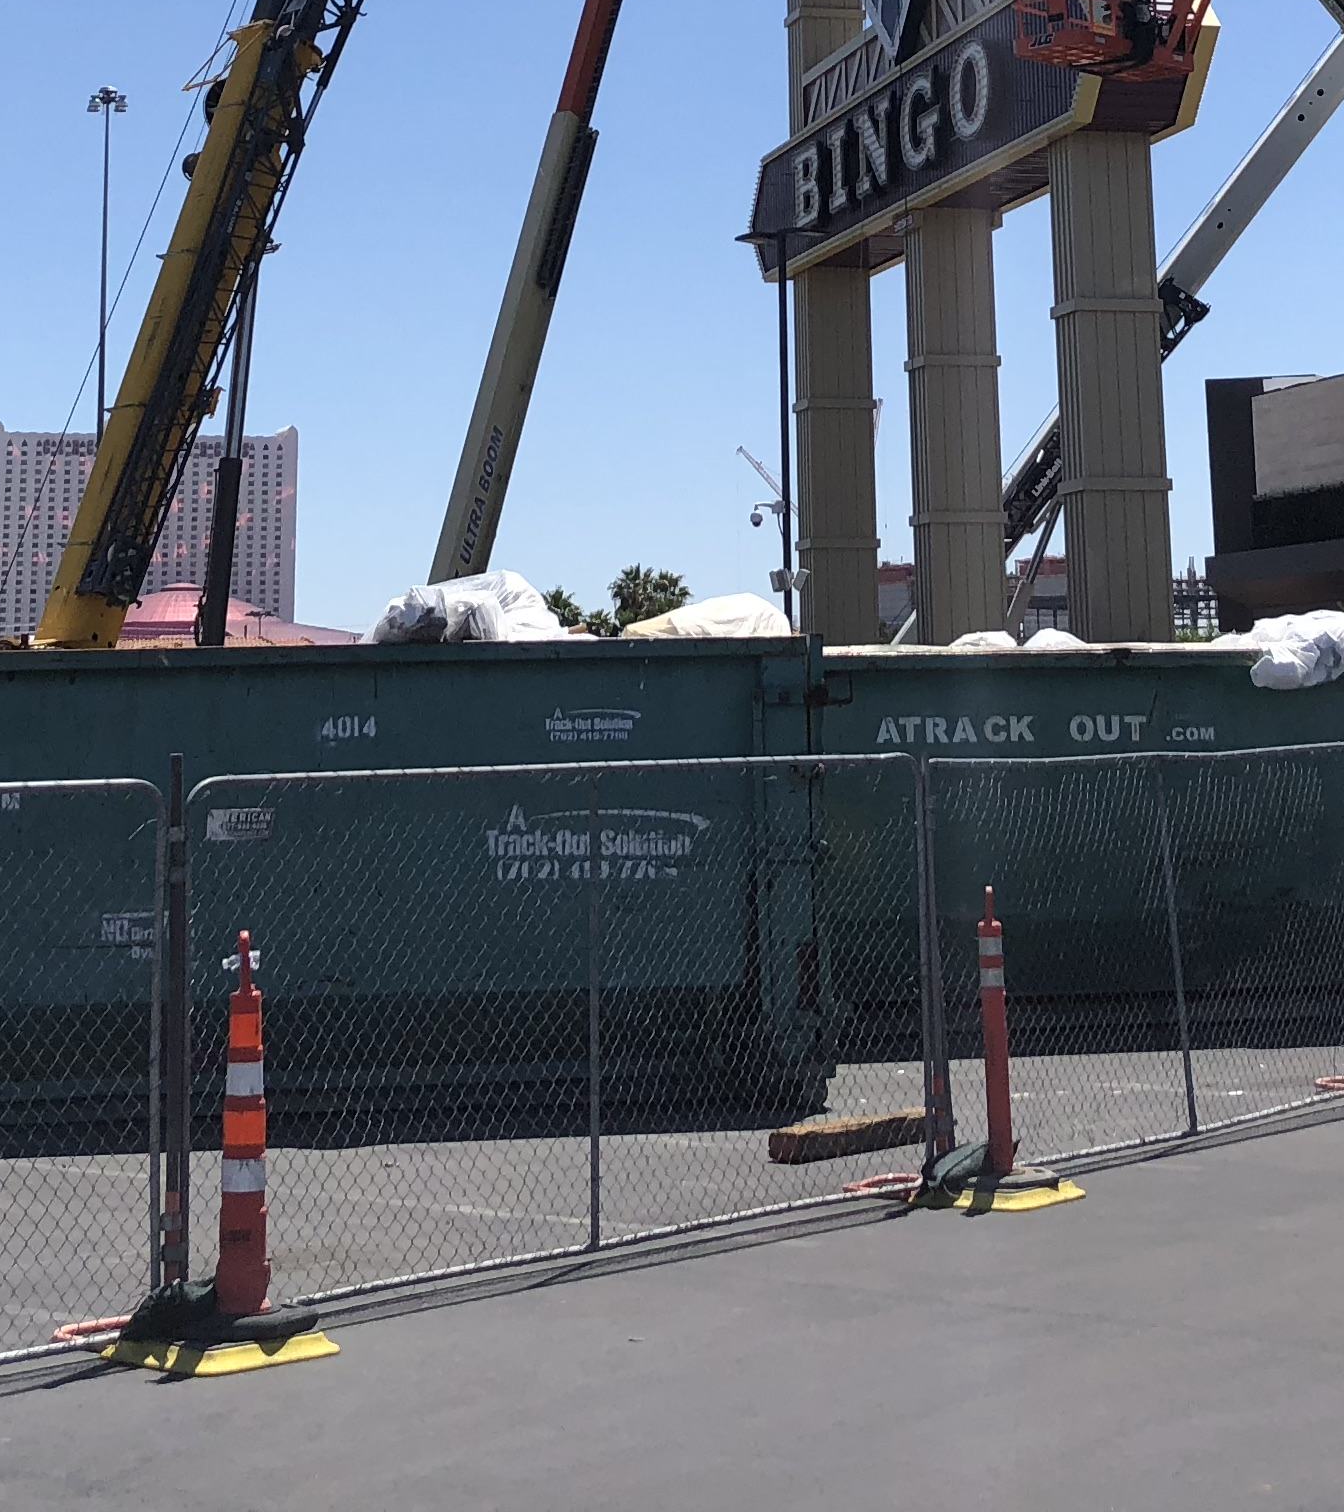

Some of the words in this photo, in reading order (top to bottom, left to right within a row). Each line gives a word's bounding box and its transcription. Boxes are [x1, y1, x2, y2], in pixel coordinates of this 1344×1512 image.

[1029, 33, 1053, 48] JLG
[793, 39, 990, 229] BINGO
[460, 496, 486, 565] ULTRA
[478, 425, 504, 494] BOOM
[321, 715, 377, 738] 4014
[553, 706, 563, 720] A
[876, 716, 1035, 744] ATRACK
[1069, 714, 1147, 742] OUT
[507, 803, 527, 831] A
[486, 829, 591, 856] Track-Out
[600, 829, 692, 856] Solution
